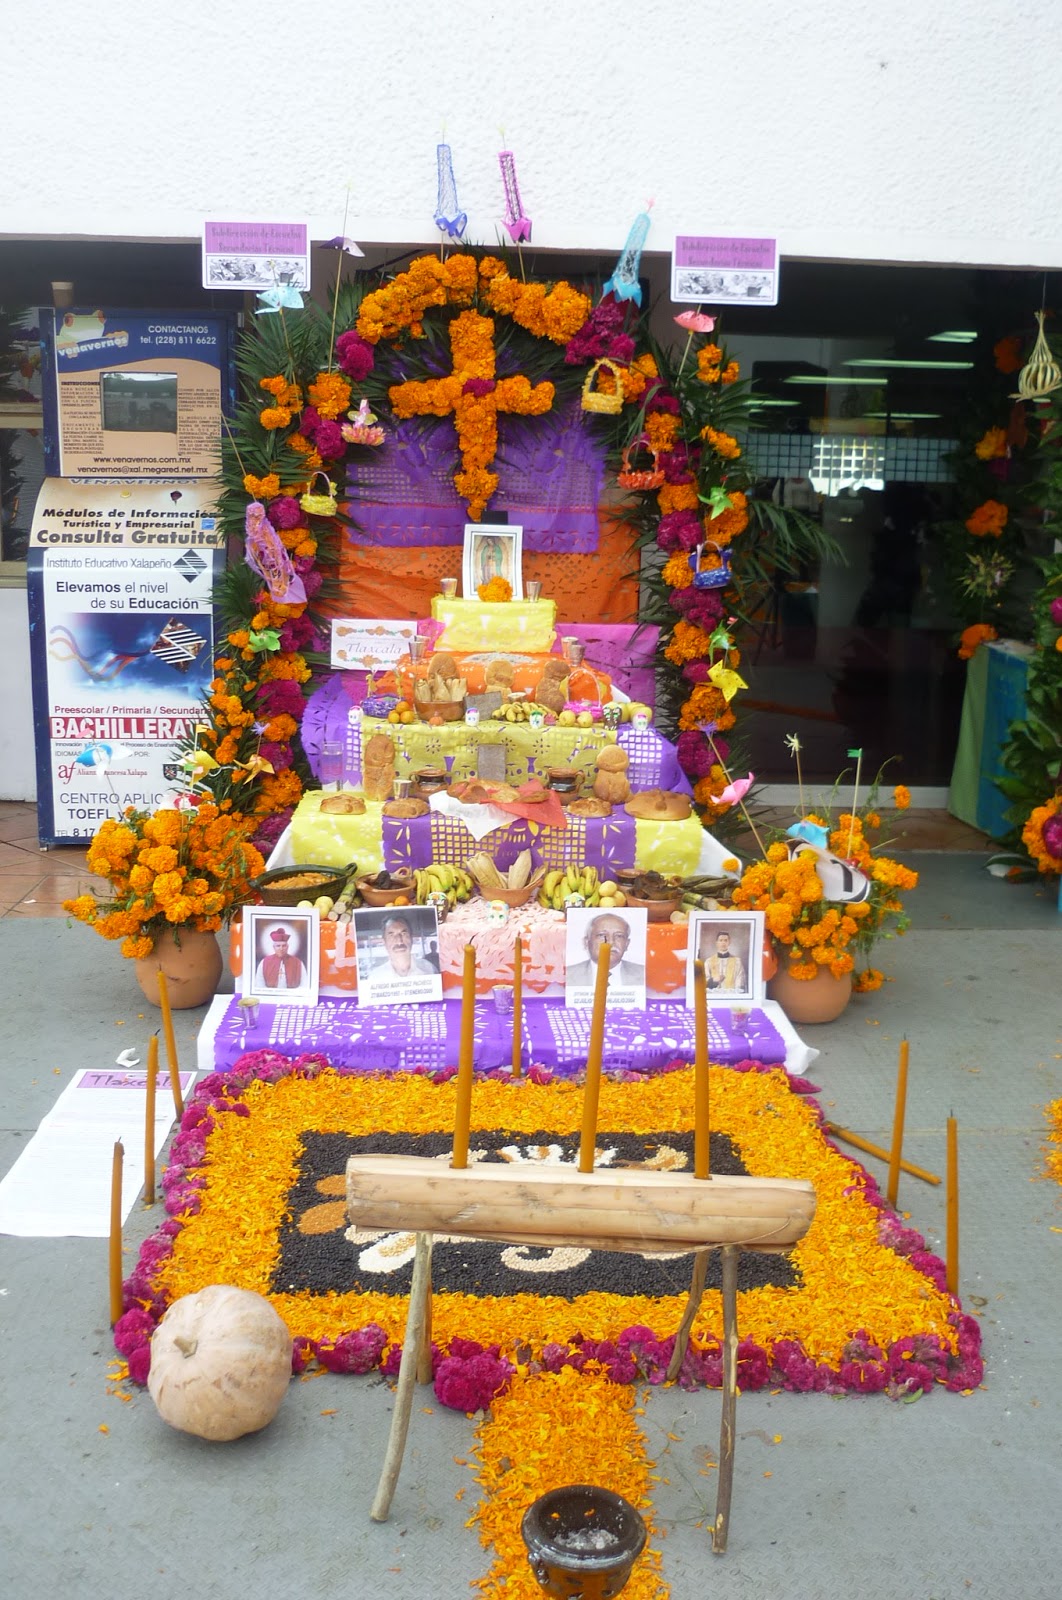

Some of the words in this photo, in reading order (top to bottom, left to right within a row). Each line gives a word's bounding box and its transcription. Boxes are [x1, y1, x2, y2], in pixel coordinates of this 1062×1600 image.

[148, 325, 209, 334] CONTACTANOS
[140, 336, 154, 344] tel.
[156, 336, 176, 345] (228)
[178, 336, 194, 344] 811
[196, 336, 217, 345] 6622
[58, 337, 128, 356] venavernos
[94, 456, 191, 464] www.venavernos.com.mx
[77, 466, 208, 474] venavernos@xal.megared.net.mx
[42, 508, 104, 518] Módulos
[108, 509, 126, 518] de
[63, 520, 111, 528] Turística
[126, 520, 194, 529] Empresarial
[37, 530, 124, 544] Consulta
[131, 530, 218, 544] Gratuita
[46, 558, 82, 568] Instituto
[85, 558, 128, 568] Educativo
[130, 558, 172, 570] Xalapeño
[56, 582, 121, 593] Elevamos
[125, 582, 136, 593] el
[140, 582, 168, 593] nivel
[90, 598, 106, 609] de
[110, 600, 124, 609] su
[129, 598, 199, 610] Educación
[345, 642, 402, 654] Tlaxcala
[54, 706, 104, 714] Preescolar
[58, 762, 76, 784] af
[60, 793, 120, 805] CENTRO
[123, 793, 164, 805] APLIC
[68, 808, 114, 819] TOEFL
[73, 828, 80, 837] 8
[90, 1075, 172, 1086] Tlaxcl
